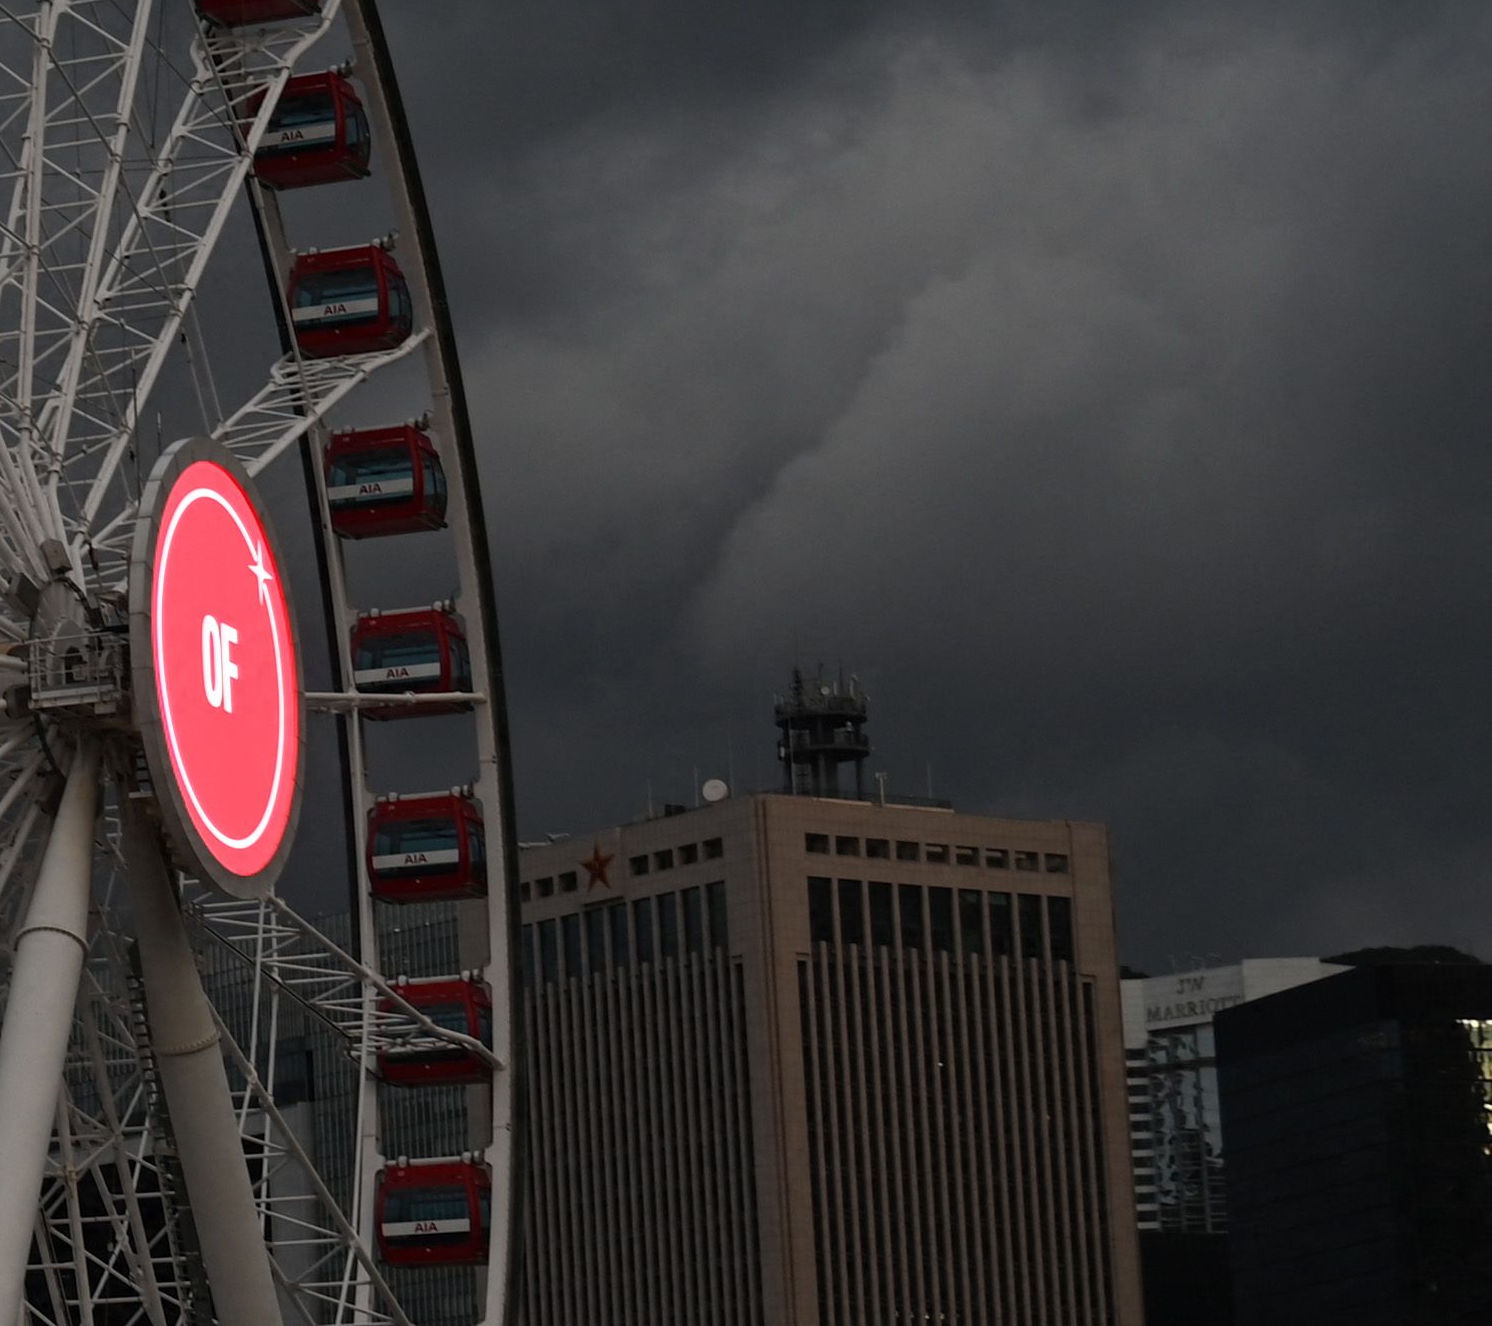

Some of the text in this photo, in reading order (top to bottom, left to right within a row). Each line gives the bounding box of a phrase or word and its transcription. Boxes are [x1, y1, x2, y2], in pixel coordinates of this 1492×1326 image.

[281, 130, 304, 142] AIA
[324, 304, 348, 316] AIA
[360, 483, 382, 495] AIA
[202, 614, 239, 714] OF
[386, 668, 410, 679] AIA
[405, 854, 429, 864] AIA
[1176, 976, 1205, 994] JW
[1147, 994, 1244, 1022] MARRIOTT
[415, 1222, 438, 1233] AIA
